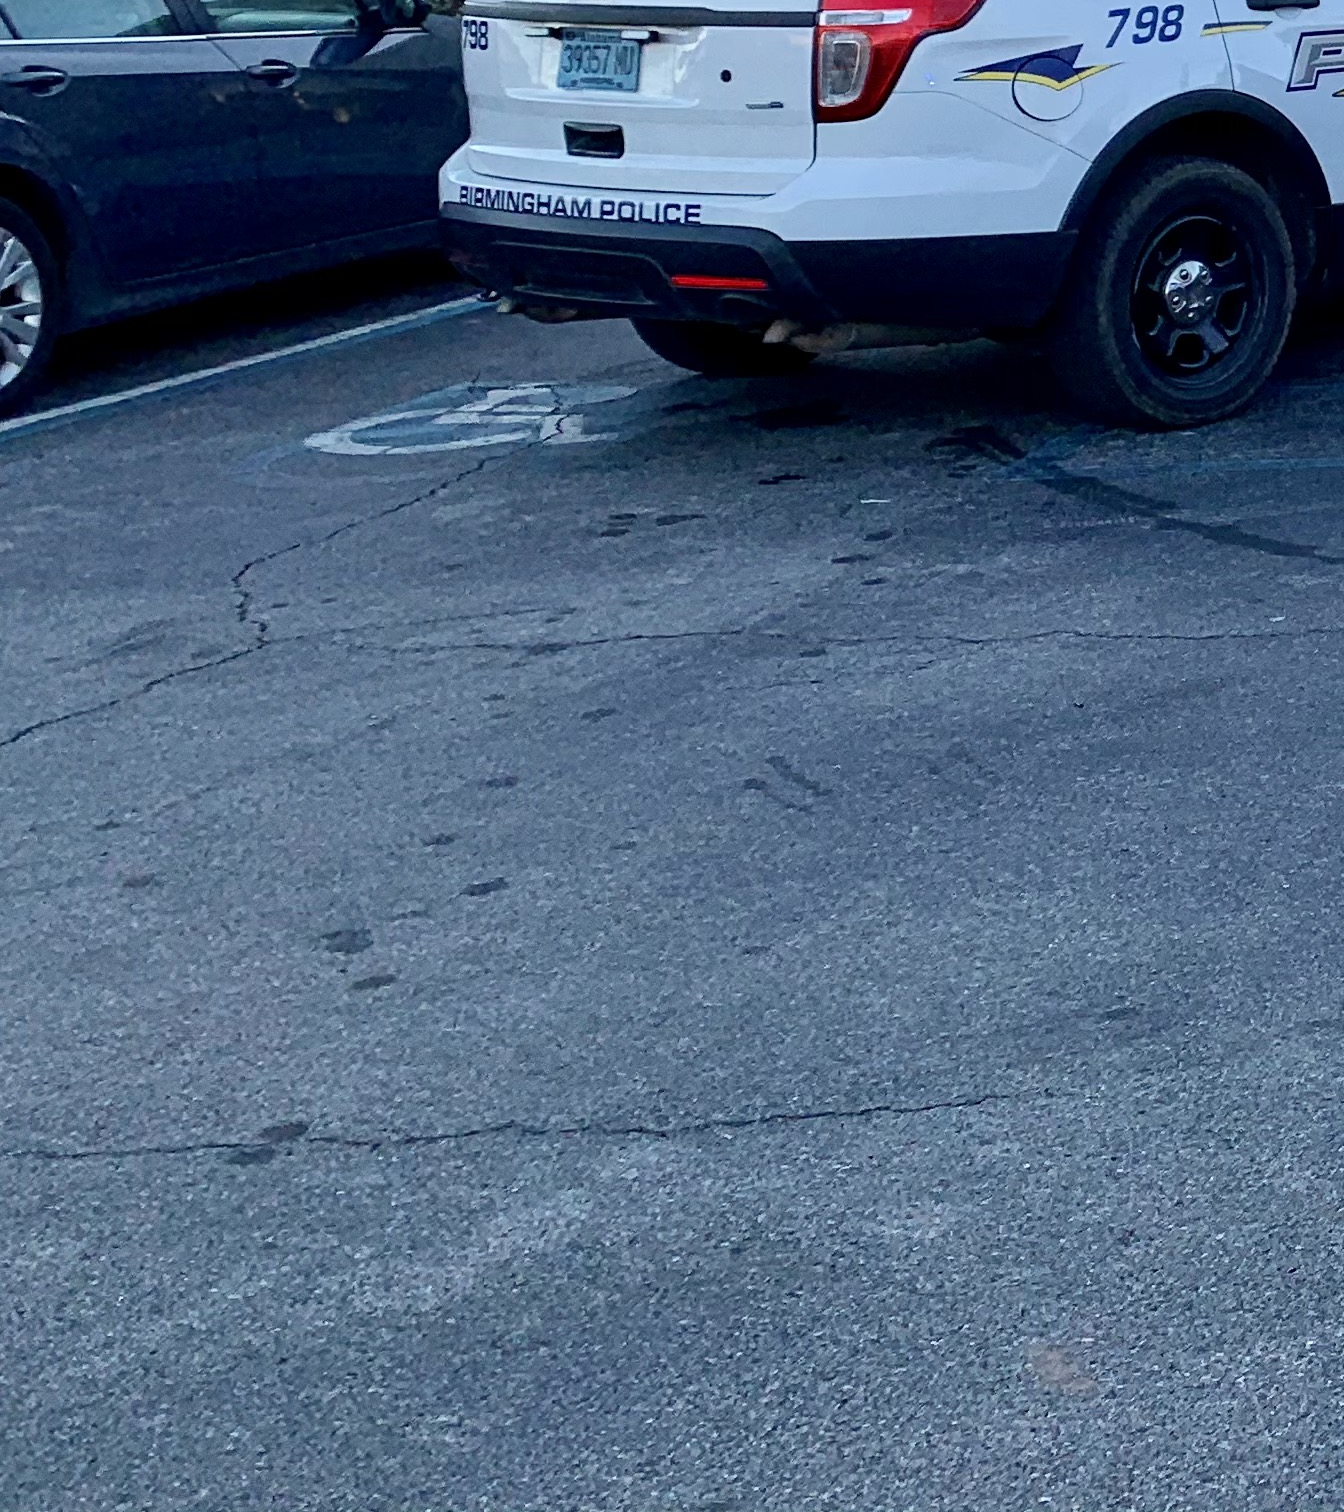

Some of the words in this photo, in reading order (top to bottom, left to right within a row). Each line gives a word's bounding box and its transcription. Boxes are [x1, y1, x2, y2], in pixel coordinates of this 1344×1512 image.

[463, 19, 489, 51] 798
[1105, 4, 1185, 49] 798
[459, 185, 592, 220] BIRMINGHAM
[599, 199, 702, 226] POLICE
